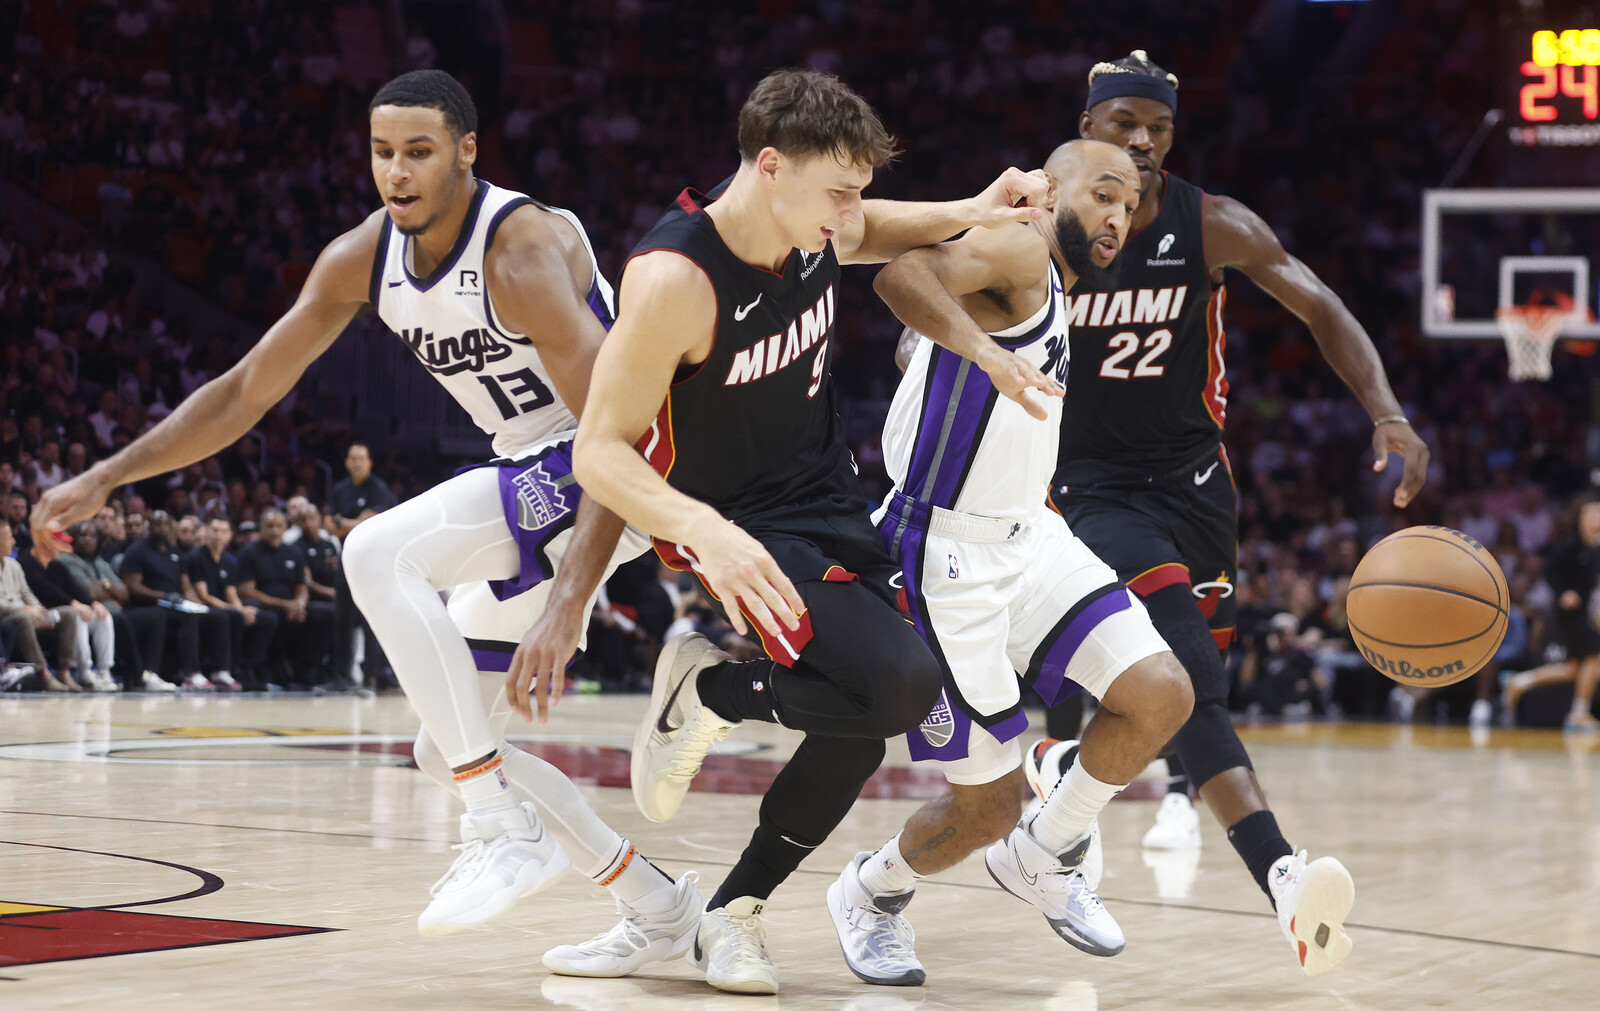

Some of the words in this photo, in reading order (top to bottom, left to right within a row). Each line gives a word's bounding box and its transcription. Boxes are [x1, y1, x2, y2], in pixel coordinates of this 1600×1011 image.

[1520, 61, 1599, 121] 24
[1147, 258, 1186, 266] Robinhood
[1065, 284, 1188, 327] MIAMI
[402, 327, 512, 376] Kings
[723, 282, 834, 386] MIAMI
[1098, 326, 1173, 380] 22
[476, 367, 554, 420] 13
[806, 337, 828, 400] 9
[515, 475, 551, 526] KINGS
[1361, 641, 1466, 679] Wilson
